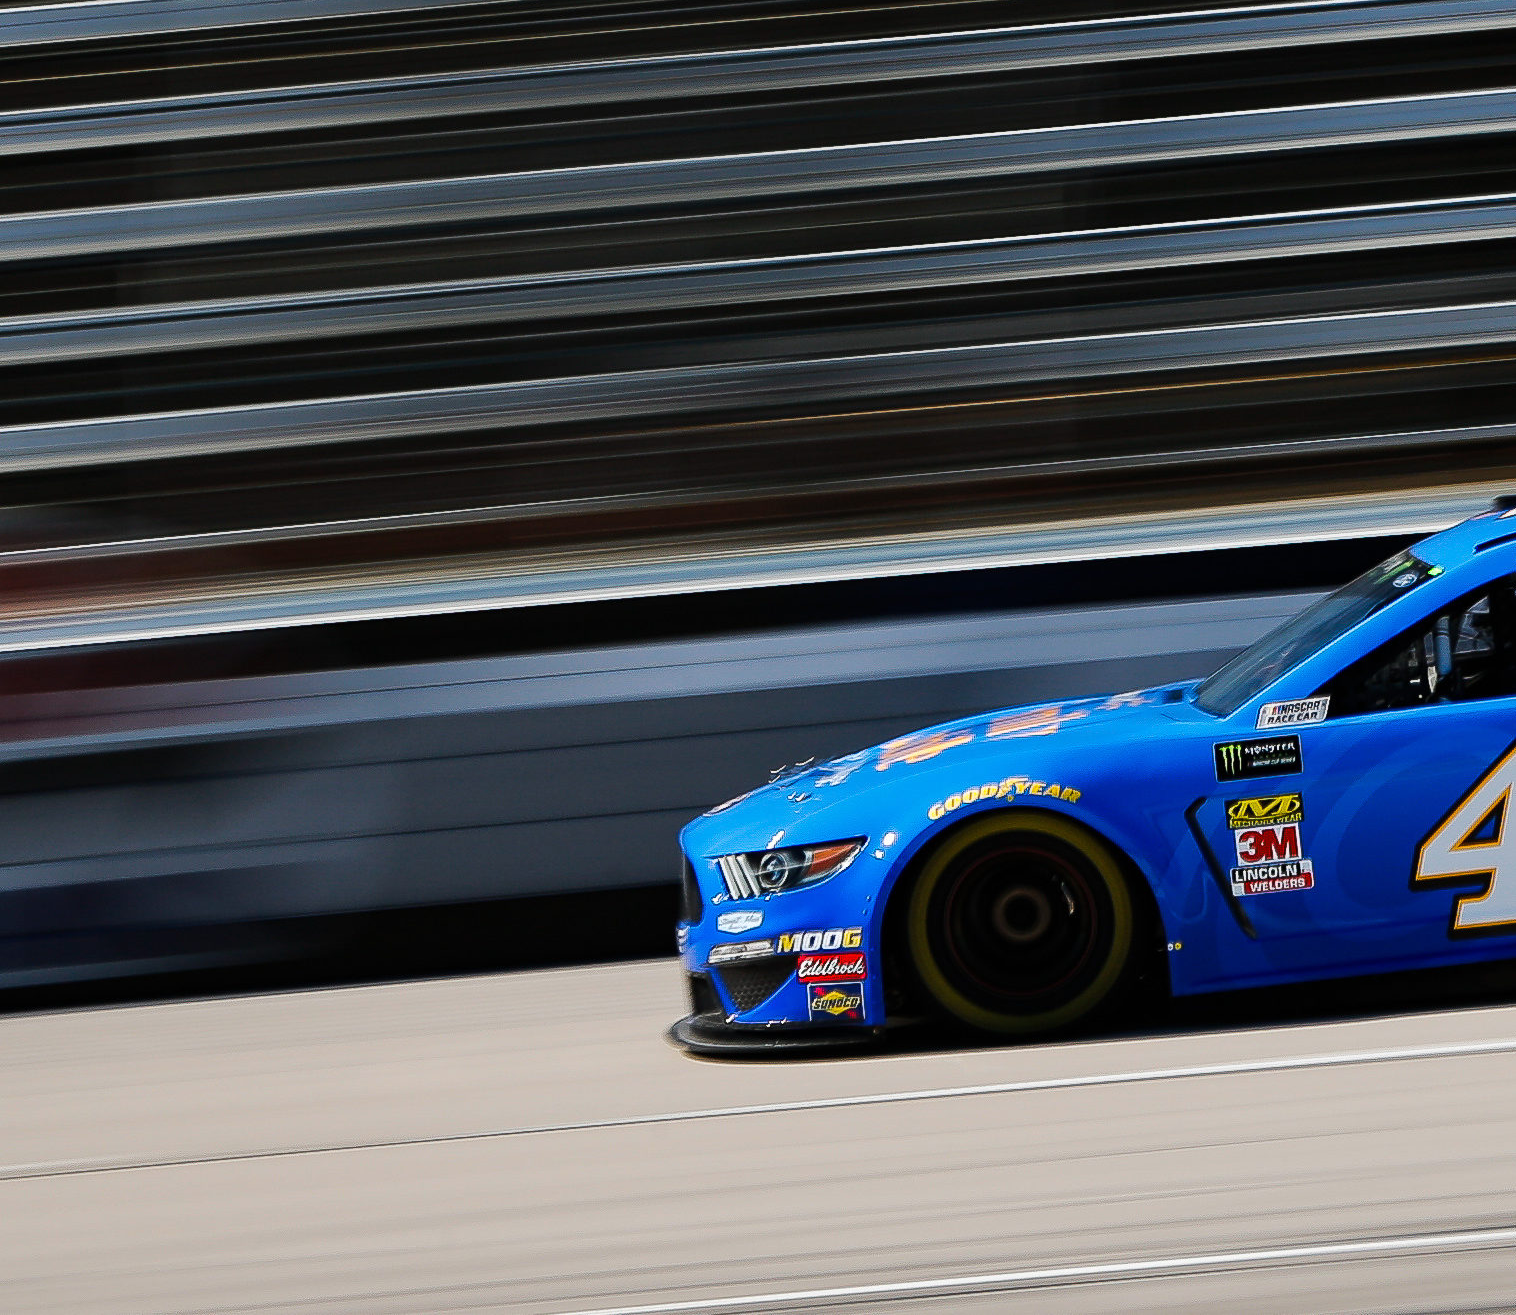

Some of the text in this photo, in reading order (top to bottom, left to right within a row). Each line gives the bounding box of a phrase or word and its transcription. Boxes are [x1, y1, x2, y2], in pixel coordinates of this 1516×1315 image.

[1278, 700, 1320, 715] NASCAR
[1267, 711, 1318, 725] RACE CAR
[1244, 742, 1296, 755] MONSTER
[927, 775, 1082, 821] GOODYEAR
[1239, 826, 1299, 863] 3M
[1235, 864, 1298, 882] LINCOLN
[1250, 877, 1306, 893] WELDERS
[777, 927, 862, 954] MOOG
[798, 957, 865, 979] Edelbrock
[812, 995, 860, 1011] SUNOCO
